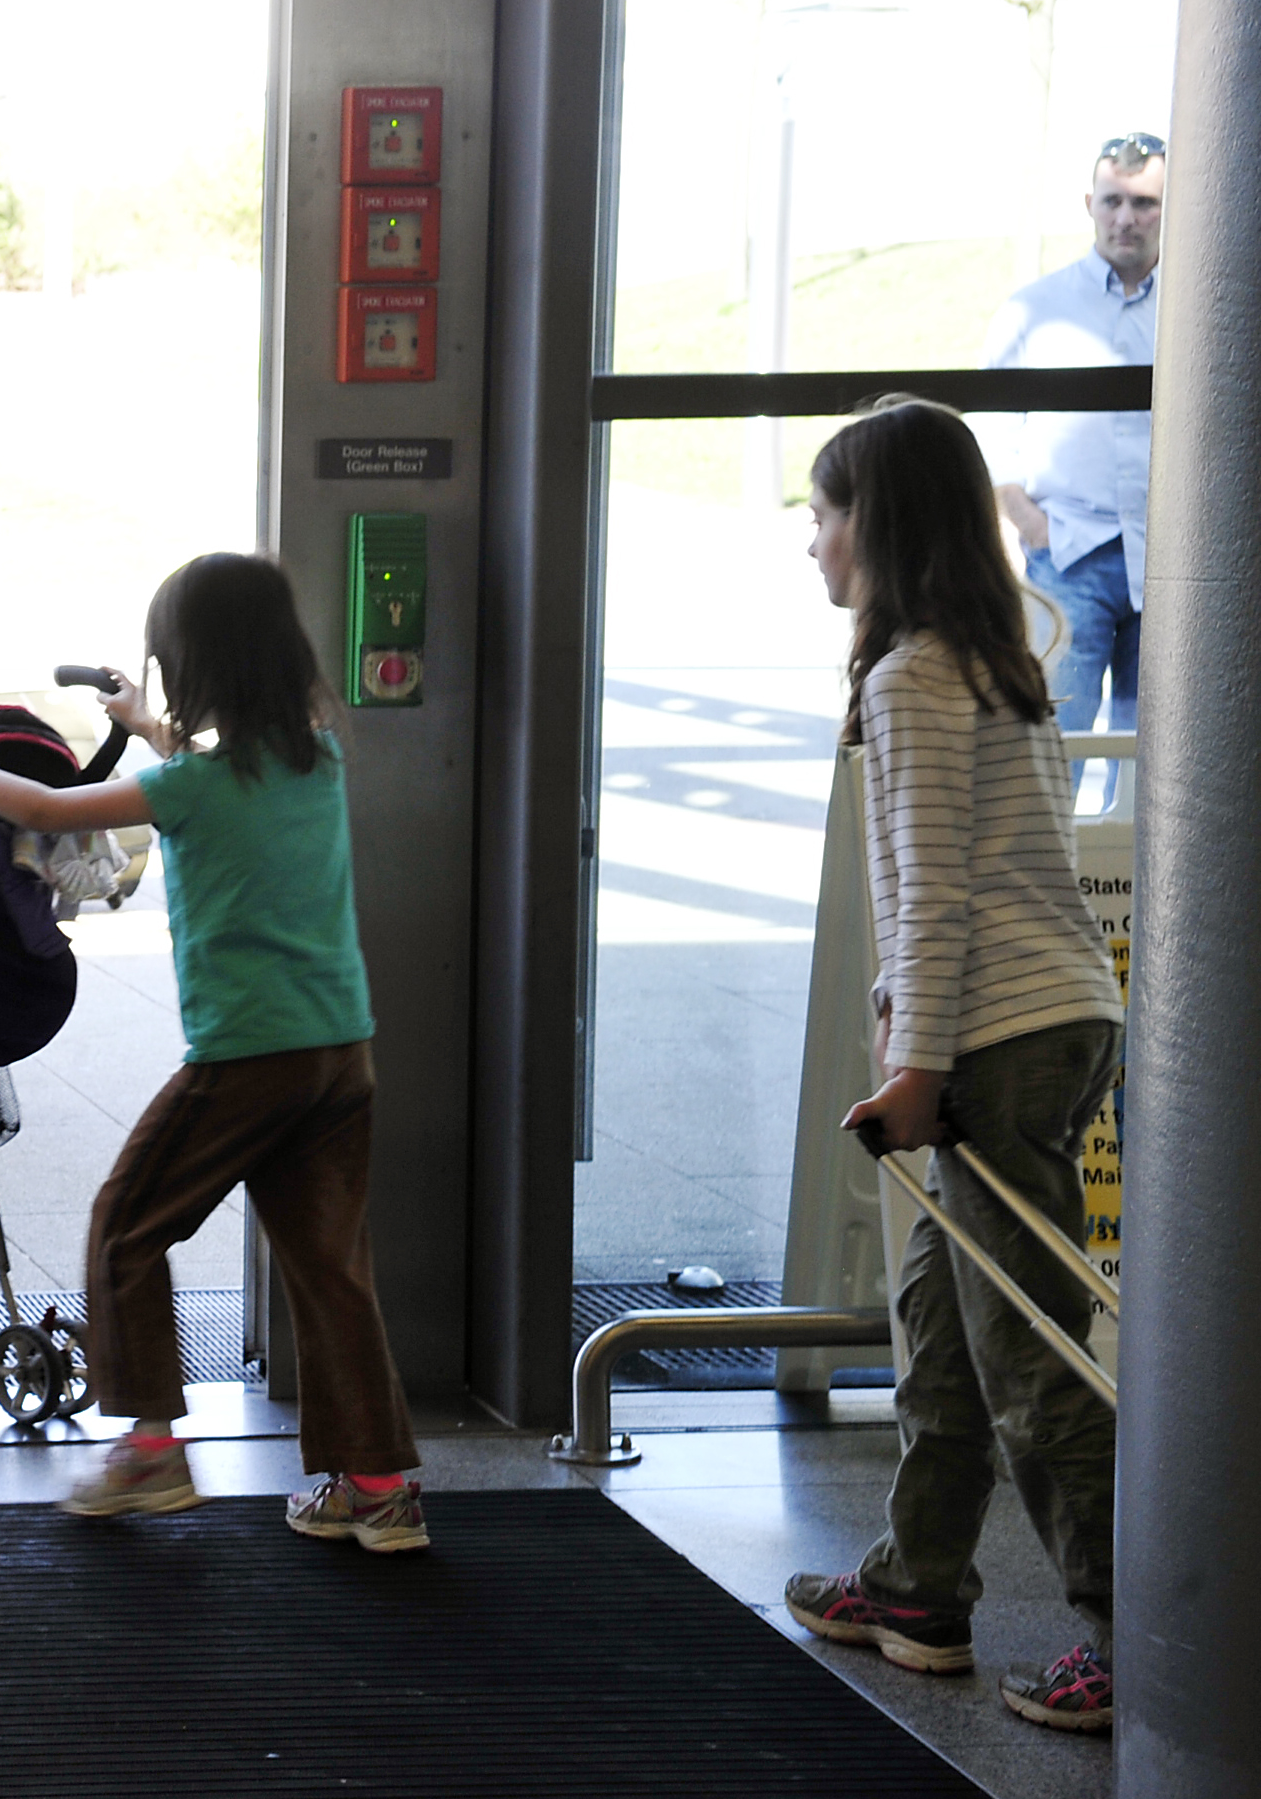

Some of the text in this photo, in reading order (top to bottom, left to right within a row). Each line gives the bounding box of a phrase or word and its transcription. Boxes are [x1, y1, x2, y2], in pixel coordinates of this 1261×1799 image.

[342, 445, 428, 458] Door Release
[346, 460, 424, 473] (Green Box)
[1079, 876, 1132, 896] State
